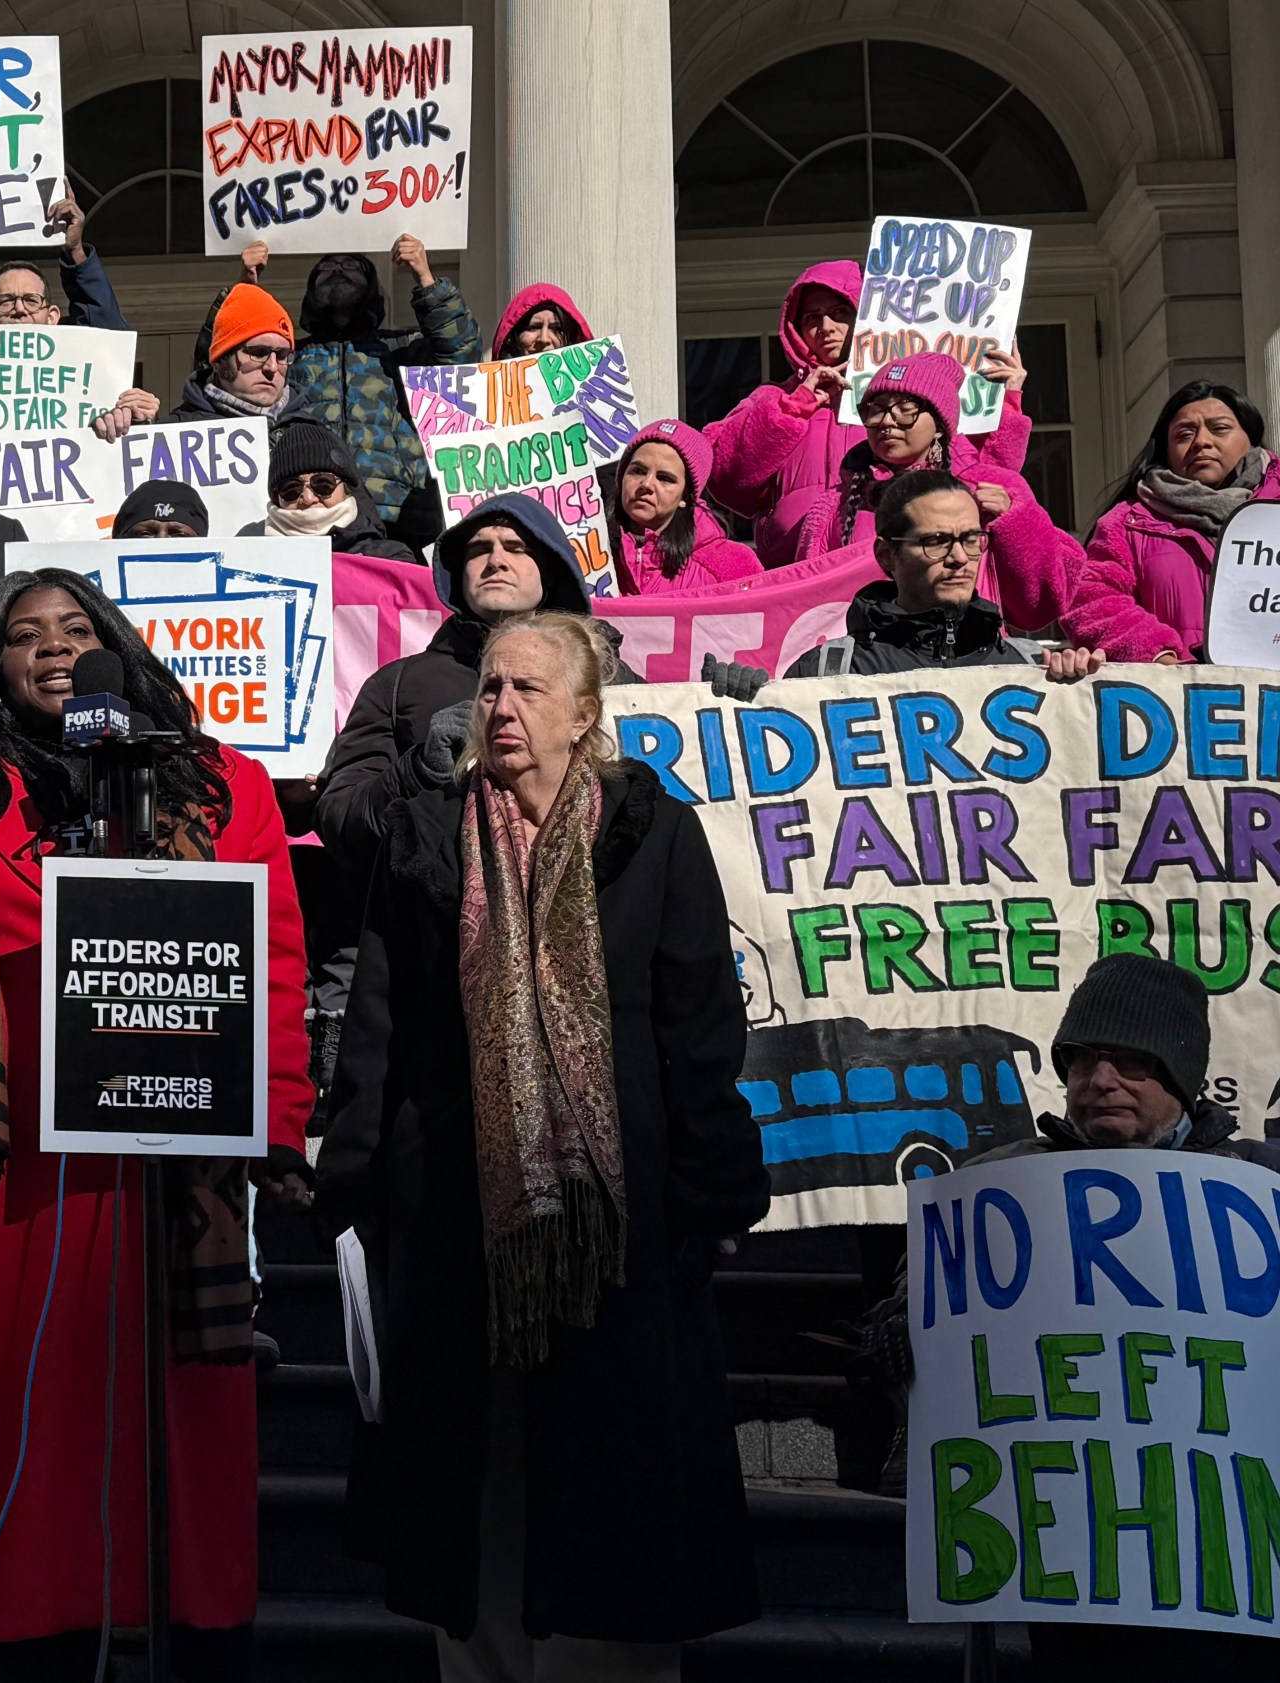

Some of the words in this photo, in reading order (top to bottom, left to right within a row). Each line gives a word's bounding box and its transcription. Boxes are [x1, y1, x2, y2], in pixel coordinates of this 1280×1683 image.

[208, 41, 318, 118] MAYOR
[316, 36, 452, 108] MAMDANI
[206, 114, 363, 177] EXPAND
[365, 101, 451, 160] FAIR
[208, 168, 328, 240] FARES
[867, 219, 967, 279] SPEED
[858, 276, 942, 324] FREE
[853, 328, 930, 372] FUND
[13, 397, 67, 430] FAIR
[405, 366, 477, 418] FREE
[479, 358, 543, 427] THE
[122, 427, 259, 496] FARES
[434, 423, 588, 494] TRANSIT
[1231, 540, 1280, 566] Th
[163, 617, 265, 651] YORK
[164, 656, 252, 677] NITIES
[256, 655, 267, 676] FOR
[613, 685, 1051, 803] RIDERS
[1091, 681, 1280, 783] DE
[752, 786, 1037, 894] FAIR
[71, 938, 180, 965] RIDERS
[187, 942, 240, 967] FOR
[788, 898, 1061, 998] FREE
[63, 970, 247, 999] AFFORDABLE
[91, 1002, 220, 1030] TRANSIT
[97, 1091, 213, 1110] ALLIANCE
[126, 1075, 213, 1093] RIDERS
[923, 1188, 1033, 1329] NO
[1063, 1168, 1280, 1318] RID
[971, 1333, 1247, 1437] LEFT
